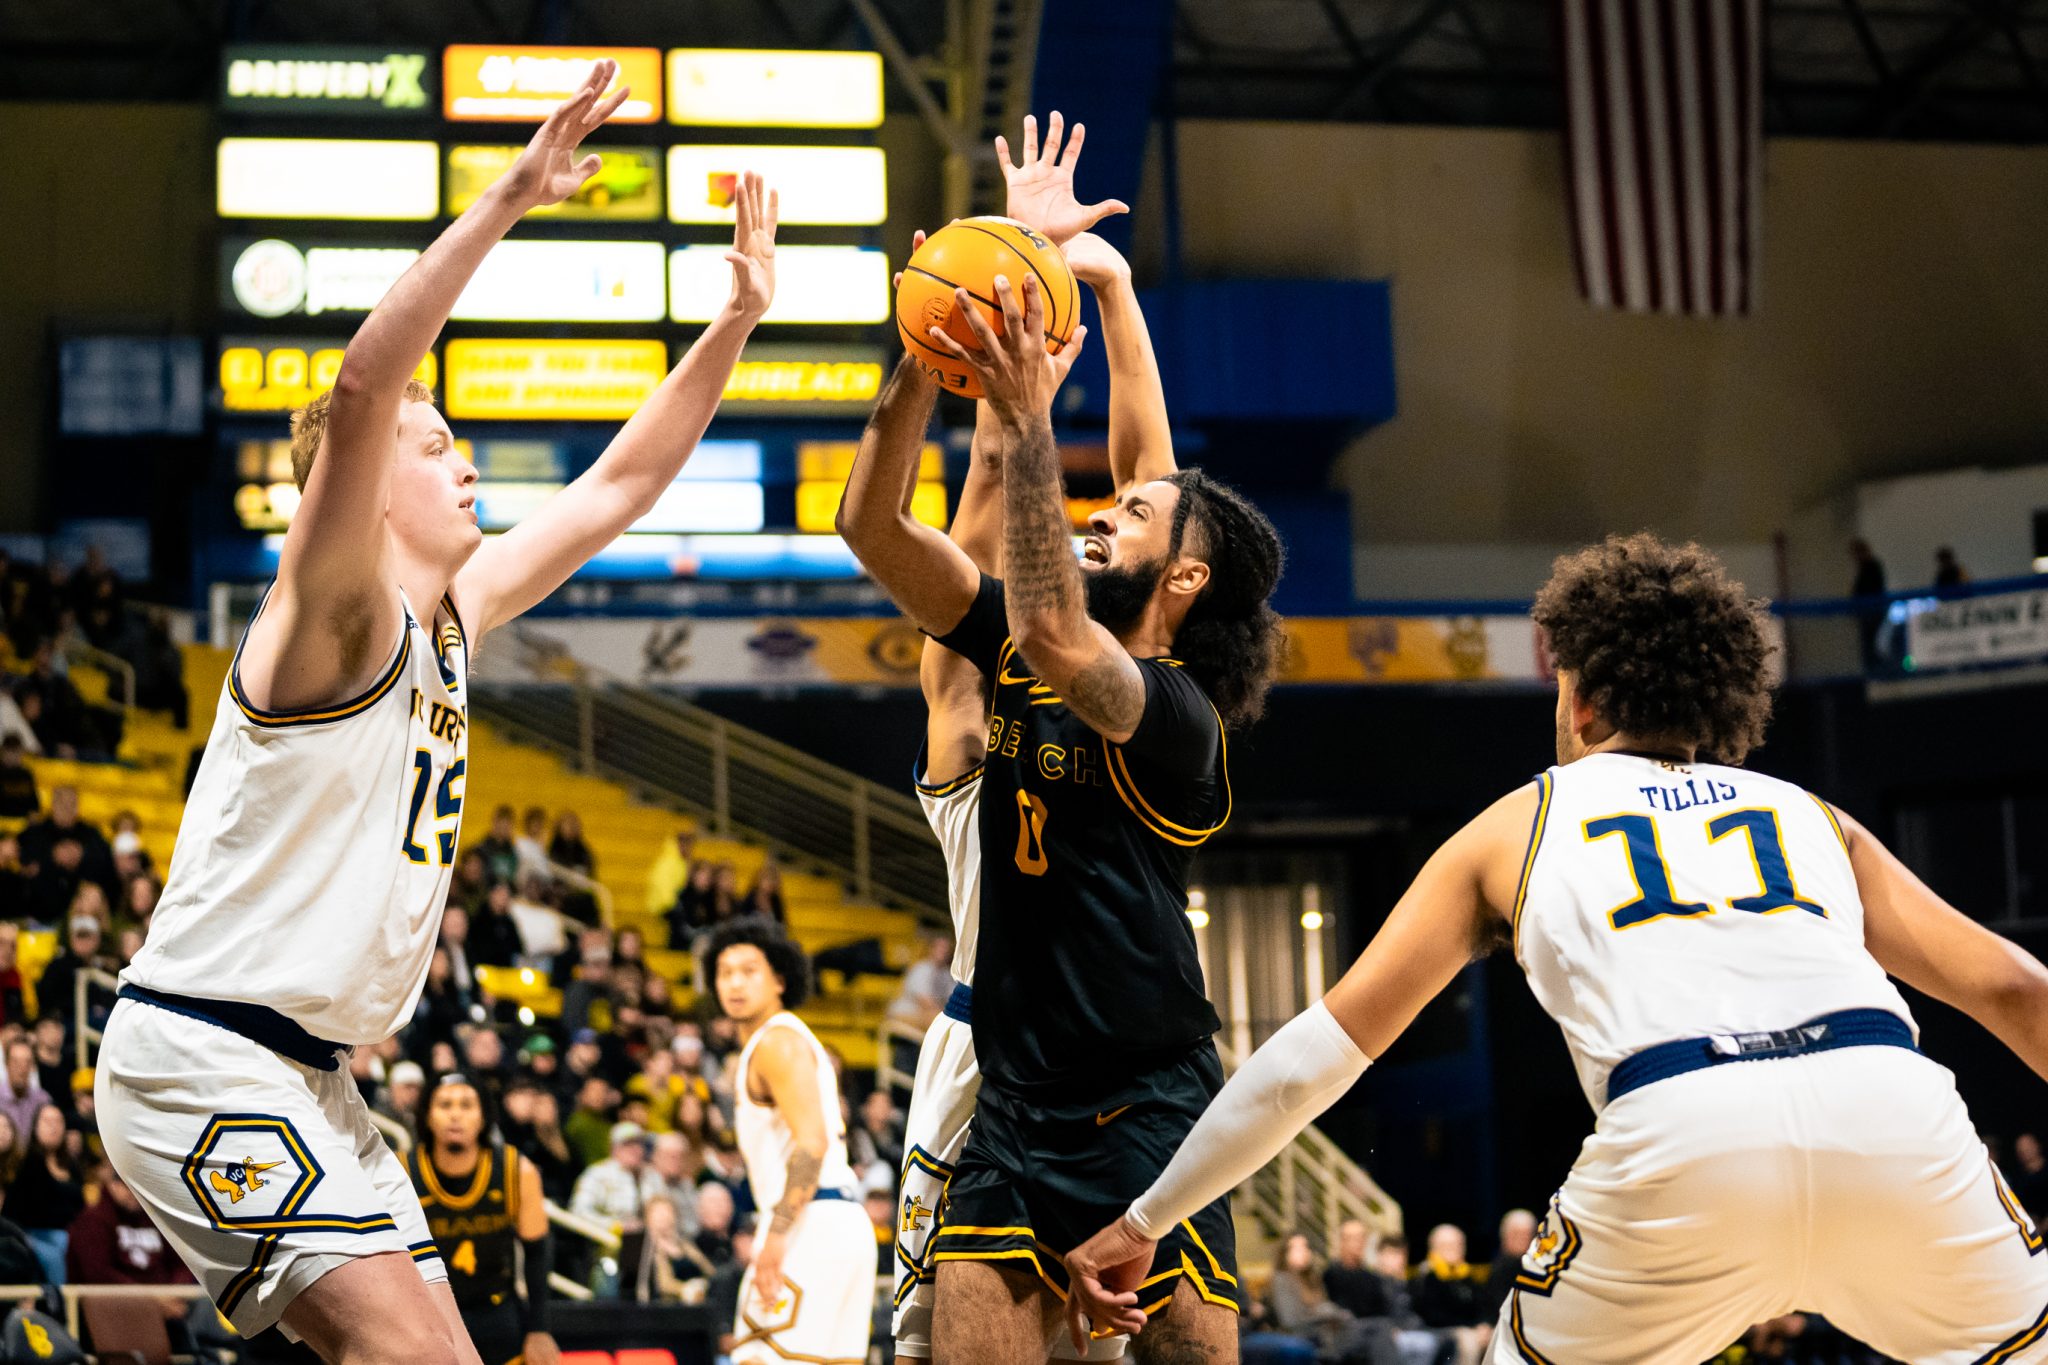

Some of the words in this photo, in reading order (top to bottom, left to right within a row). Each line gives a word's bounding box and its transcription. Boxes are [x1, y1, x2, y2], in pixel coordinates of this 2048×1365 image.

[987, 715, 1105, 787] BECH
[401, 746, 466, 867] 15
[1639, 778, 1738, 812] TILLIS
[1014, 788, 1049, 877] 0
[1581, 806, 1831, 931] 11
[230, 1167, 247, 1182] UCI
[451, 1238, 478, 1277] 4
